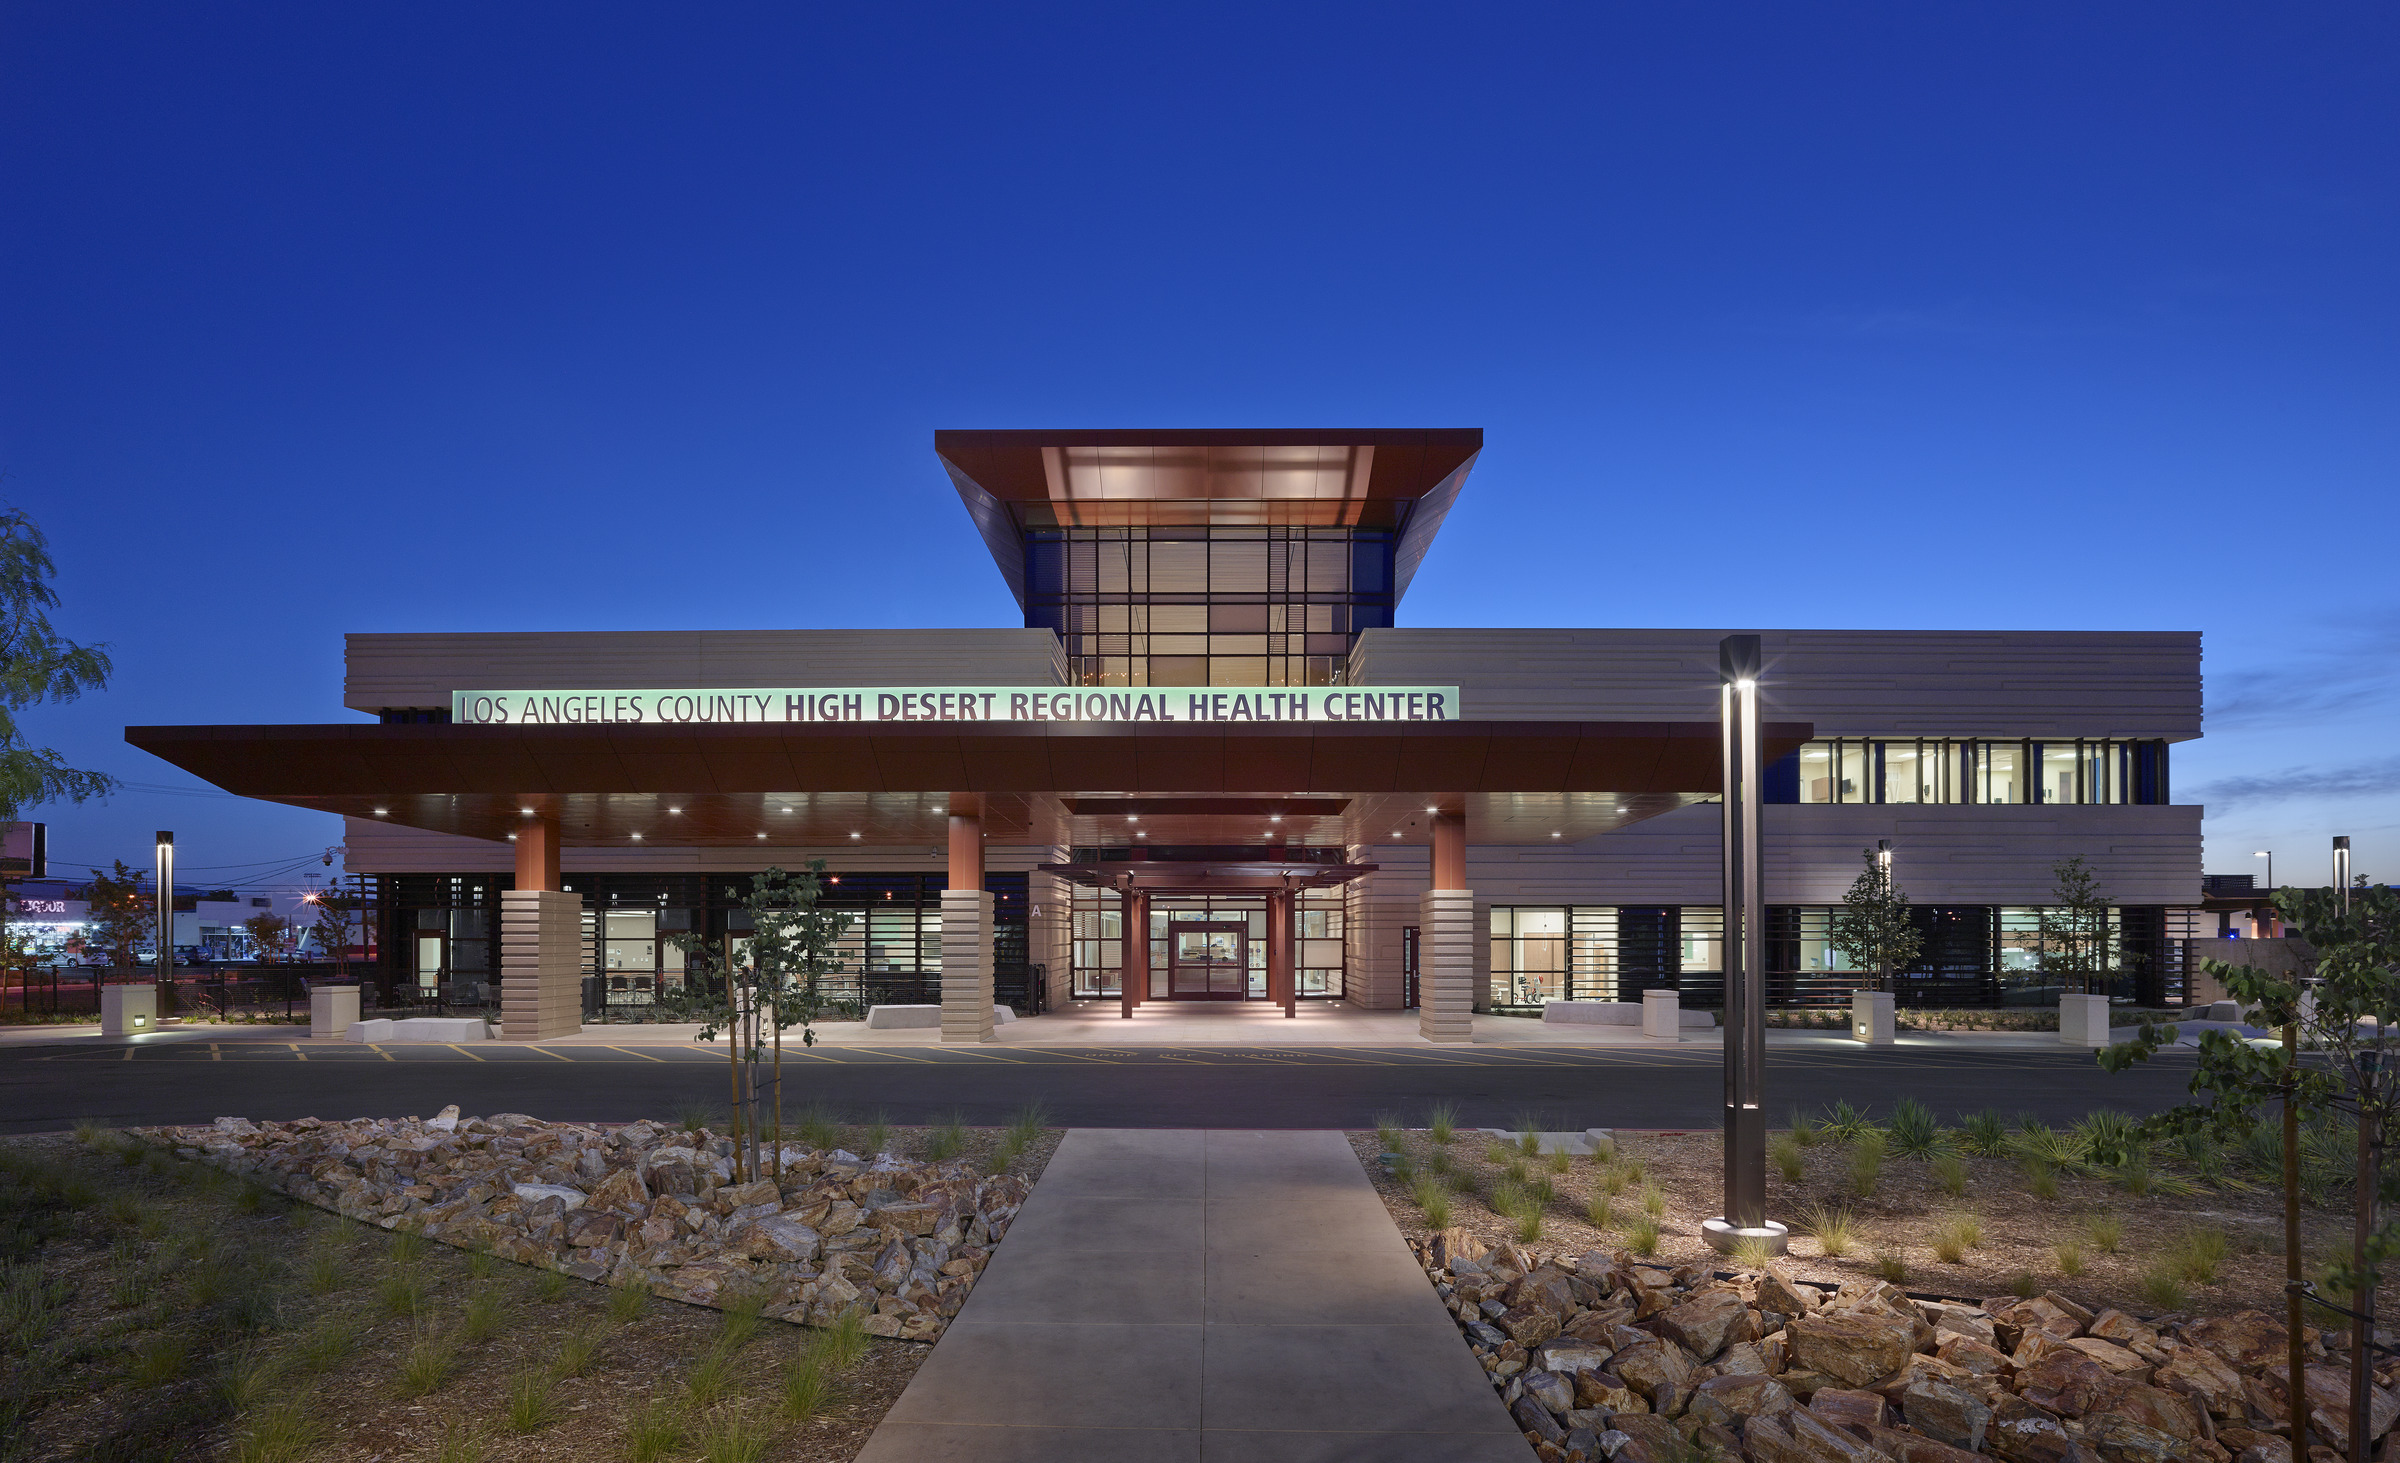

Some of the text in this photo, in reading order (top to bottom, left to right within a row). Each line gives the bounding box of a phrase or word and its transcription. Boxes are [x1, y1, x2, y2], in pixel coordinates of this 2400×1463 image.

[460, 692, 1446, 723] LOS ANGELES COUNTY HIGH DESERT REGIONAL HEALTH CENTER
[1031, 904, 1042, 917] A
